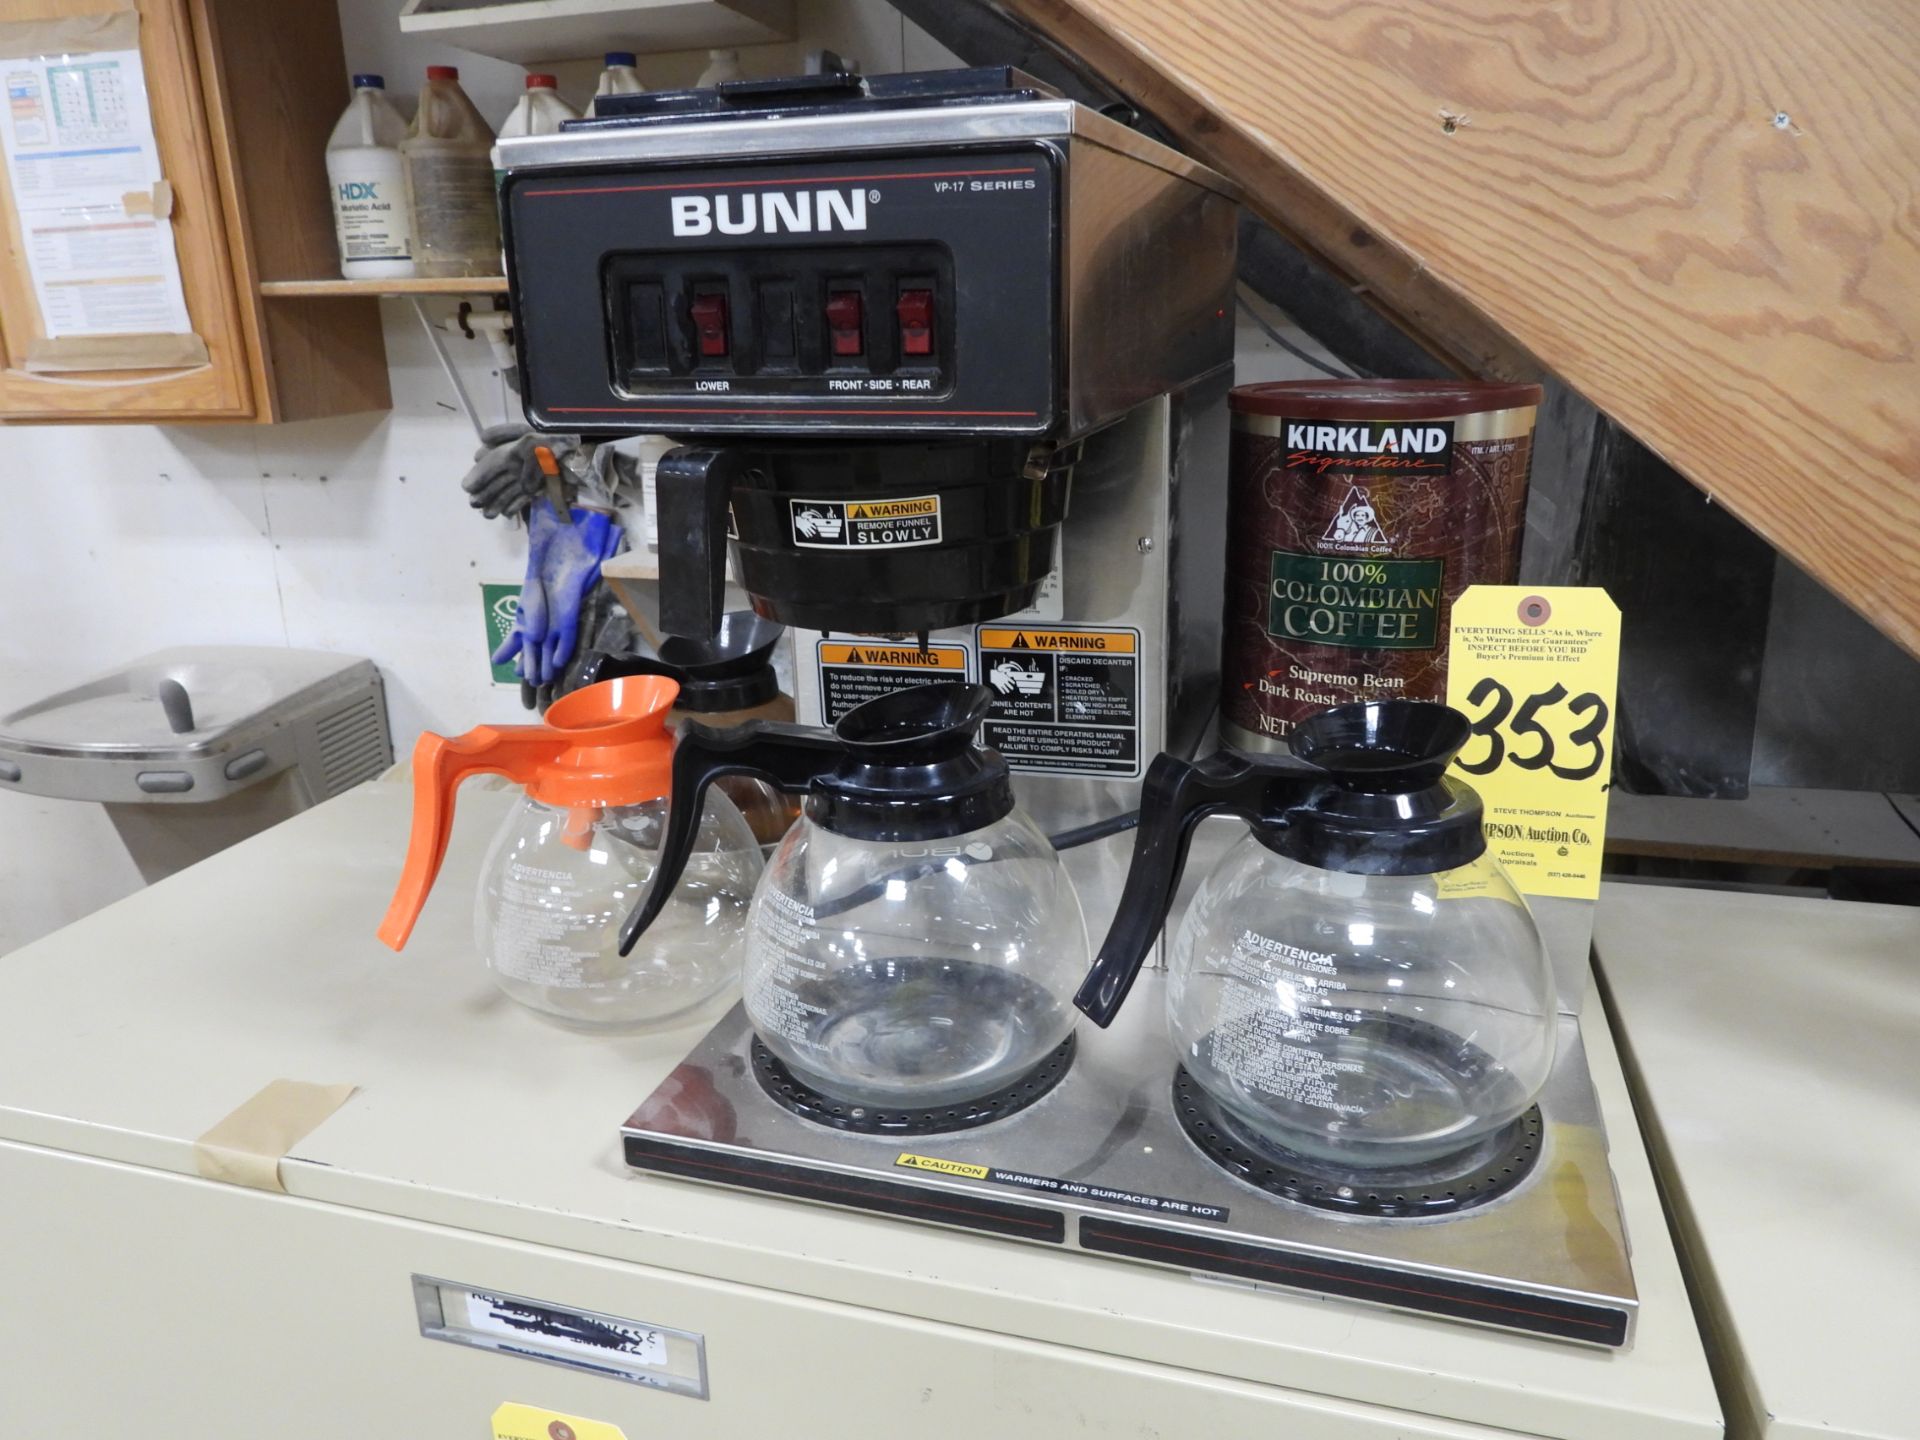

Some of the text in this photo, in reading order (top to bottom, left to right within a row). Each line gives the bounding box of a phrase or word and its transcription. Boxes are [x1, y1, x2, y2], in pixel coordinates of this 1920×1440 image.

[338, 182, 379, 201] HDX
[934, 180, 1036, 193] VP-17 SERIES
[371, 202, 391, 211] Acid
[695, 381, 730, 392] LOWER
[829, 379, 931, 391] FRONT SIDE REAR
[1287, 423, 1447, 454] KIRKLAND
[1286, 450, 1446, 474] Signature
[870, 501, 932, 516] WARNING
[857, 518, 932, 531] REMOVE FUNNEL
[857, 526, 932, 544] SLOWLY
[1316, 541, 1393, 553] 100% Colombian Coffee
[1320, 561, 1388, 585] 100%
[1272, 578, 1437, 610] COLOMBIAN
[1283, 604, 1419, 640] COFFEE
[1454, 627, 1515, 636] EVERYTHING
[1517, 628, 1546, 636] SELLS
[1034, 635, 1106, 649] WARNING
[1474, 635, 1485, 643] No
[1486, 636, 1530, 645] Warranties
[1467, 644, 1587, 654] INSPECT BEFORE YOU BID
[865, 650, 939, 666] WARNING
[1059, 657, 1133, 667] DISCARD DECANTER
[1476, 653, 1506, 662] Buyer's
[1508, 653, 1544, 662] Premium
[1556, 655, 1580, 663] Effect
[829, 672, 838, 681] To
[840, 674, 865, 682] reduce
[866, 675, 878, 683] the
[880, 675, 894, 683] risk
[895, 676, 903, 684] of
[904, 676, 931, 685] electric
[1289, 665, 1405, 688] Supremo Bean
[830, 683, 840, 691] do
[1258, 678, 1290, 699] Dark
[1294, 689, 1337, 706] Roast
[1014, 702, 1052, 710] CONTENTS
[1258, 713, 1289, 736] NET
[1453, 677, 1609, 781] 353
[1007, 735, 1035, 743] BEFORE
[1037, 737, 1059, 745] USING
[1076, 739, 1111, 747] PRODUCT
[1054, 730, 1094, 739] OPERATING
[1095, 731, 1126, 740] MANUAL
[1030, 743, 1039, 751] TO
[1040, 744, 1069, 753] COMPLY
[1071, 746, 1093, 754] RISKS
[1093, 747, 1120, 756] INJURY
[1493, 807, 1517, 815] STEVE
[1519, 809, 1561, 817] THOMPSON
[1526, 826, 1570, 843] Auction
[1500, 849, 1535, 858] Auctions
[512, 862, 573, 880] ADVERTENCIA
[1243, 930, 1334, 967] ADVERTENCIA
[1302, 961, 1338, 976] LESIONES
[1318, 979, 1347, 991] ARRIBA
[1300, 1005, 1343, 1021] MATERIALES
[1324, 1023, 1350, 1036] SOBRE
[1282, 1043, 1323, 1060] CONTIENEN
[1306, 1056, 1321, 1067] LAS
[1306, 1077, 1326, 1088] TIPO
[1328, 1082, 1339, 1091] DE
[1293, 1094, 1304, 1104] SE
[1307, 1092, 1334, 1103] JARRA
[921, 1159, 983, 1176] CAUTION
[995, 1171, 1220, 1217] WARMERS AND SURFACES ARE HOT
